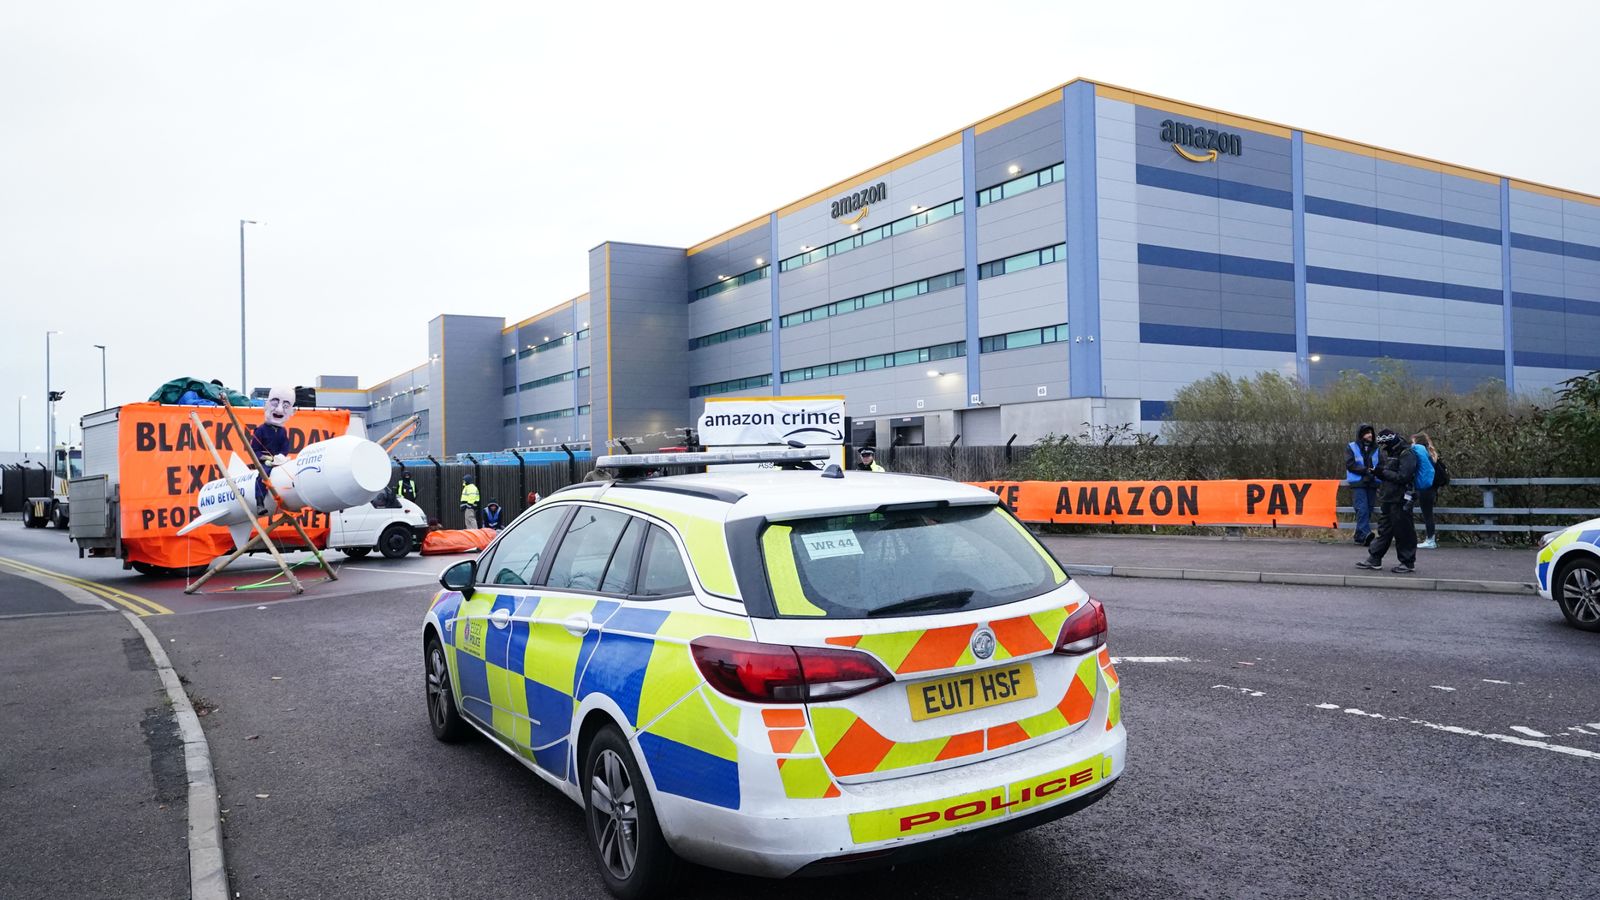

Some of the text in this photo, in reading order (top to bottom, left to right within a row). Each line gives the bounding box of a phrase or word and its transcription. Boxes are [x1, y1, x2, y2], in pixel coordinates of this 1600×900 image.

[1160, 119, 1242, 156] amazon
[831, 182, 886, 219] amazon
[705, 408, 840, 427] amazon crime
[200, 487, 245, 508] AND BEYOD
[1055, 485, 1199, 516] AMAZON
[1246, 483, 1312, 515] PAY
[811, 538, 854, 551] WR 44
[922, 668, 1020, 714] EU17 HSF
[900, 768, 1093, 832] POLICE
